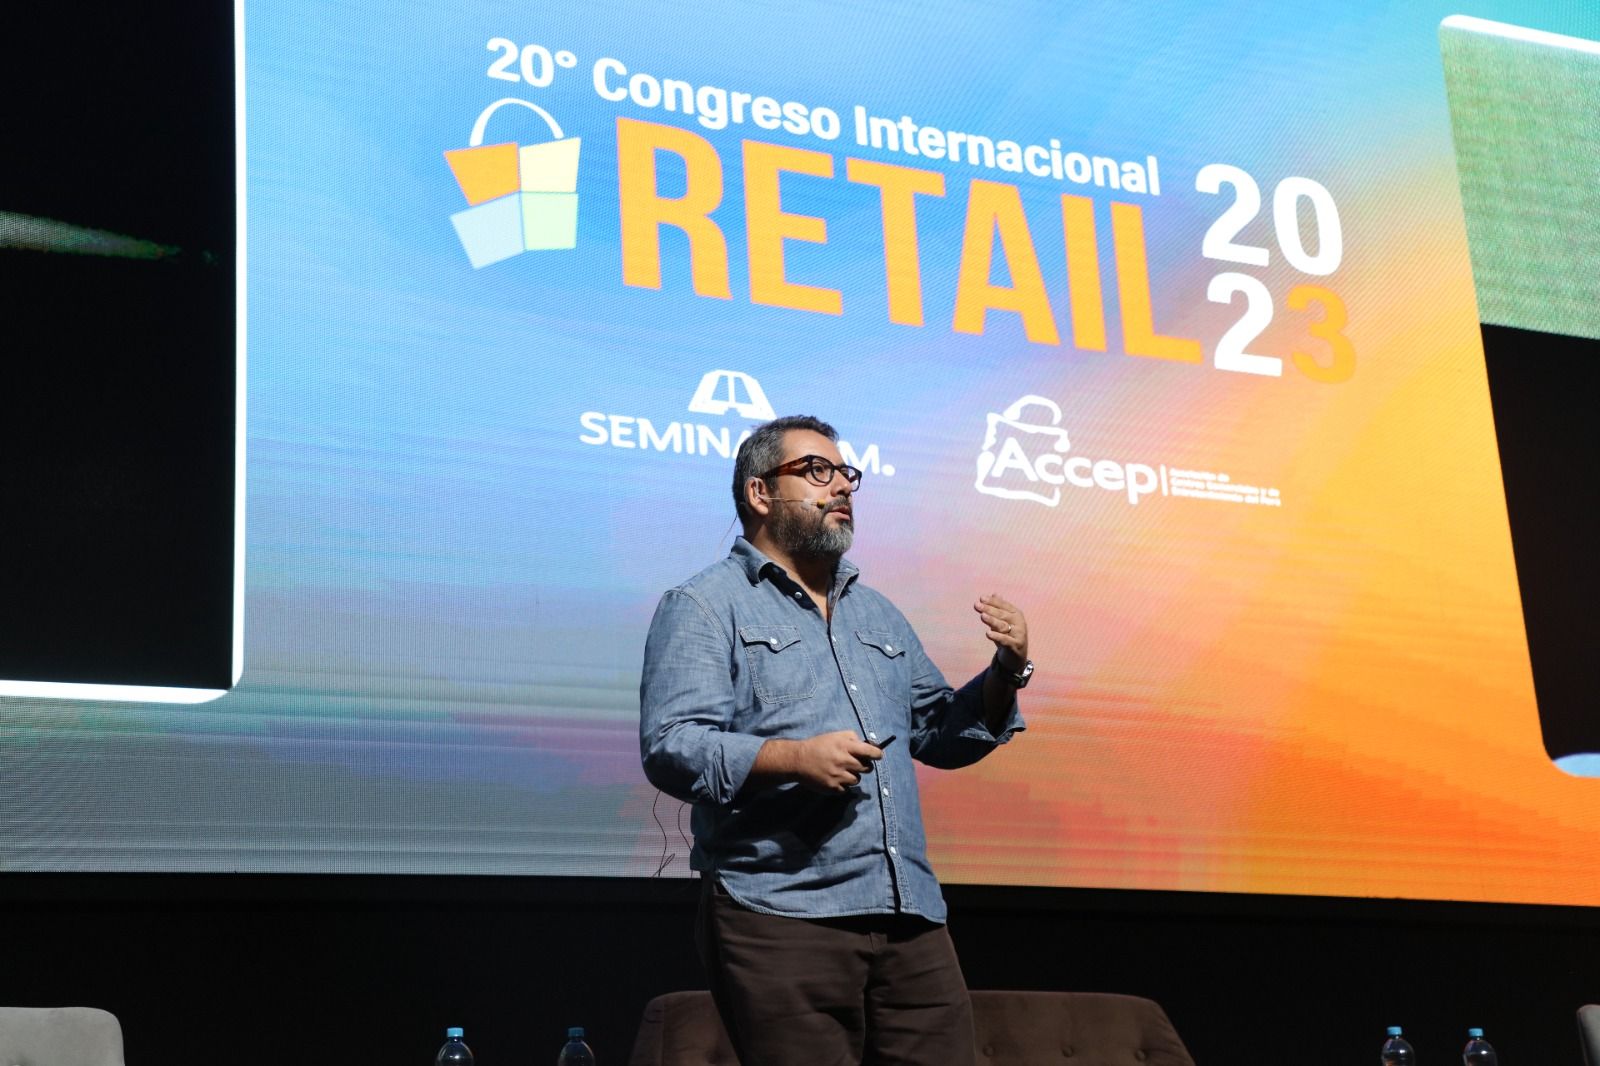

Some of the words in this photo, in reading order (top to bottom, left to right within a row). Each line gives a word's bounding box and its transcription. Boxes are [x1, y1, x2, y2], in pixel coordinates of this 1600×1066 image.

[487, 38, 577, 87] 20°
[593, 57, 841, 140] Congreso
[854, 105, 1160, 195] Internacional
[616, 117, 1202, 363] RETAIL
[1195, 163, 1343, 276] 20
[1207, 272, 1357, 384] 23
[991, 436, 1158, 505] Accep
